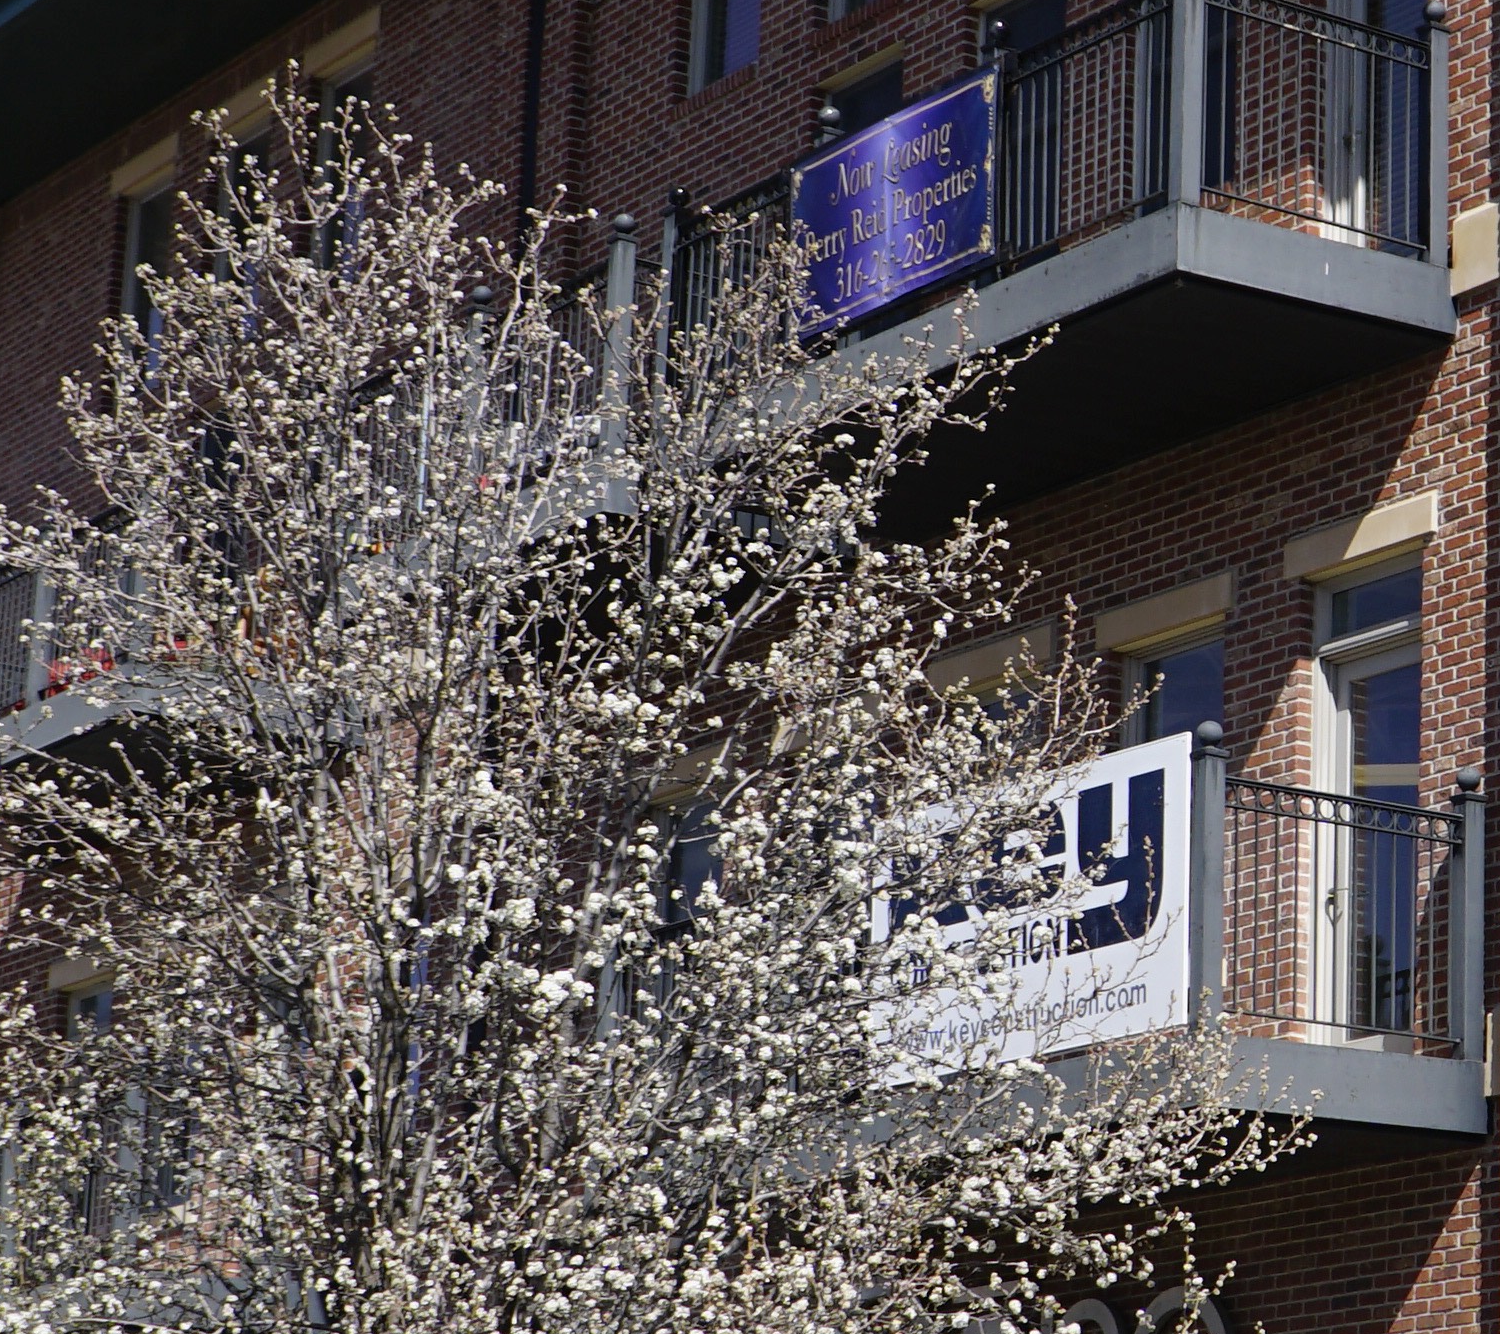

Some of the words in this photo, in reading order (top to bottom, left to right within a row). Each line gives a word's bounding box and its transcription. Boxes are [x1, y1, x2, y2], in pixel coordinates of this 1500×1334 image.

[829, 148, 875, 206] Now
[882, 121, 953, 184] Leasing
[851, 197, 887, 246] Reid
[892, 159, 978, 225] Properties
